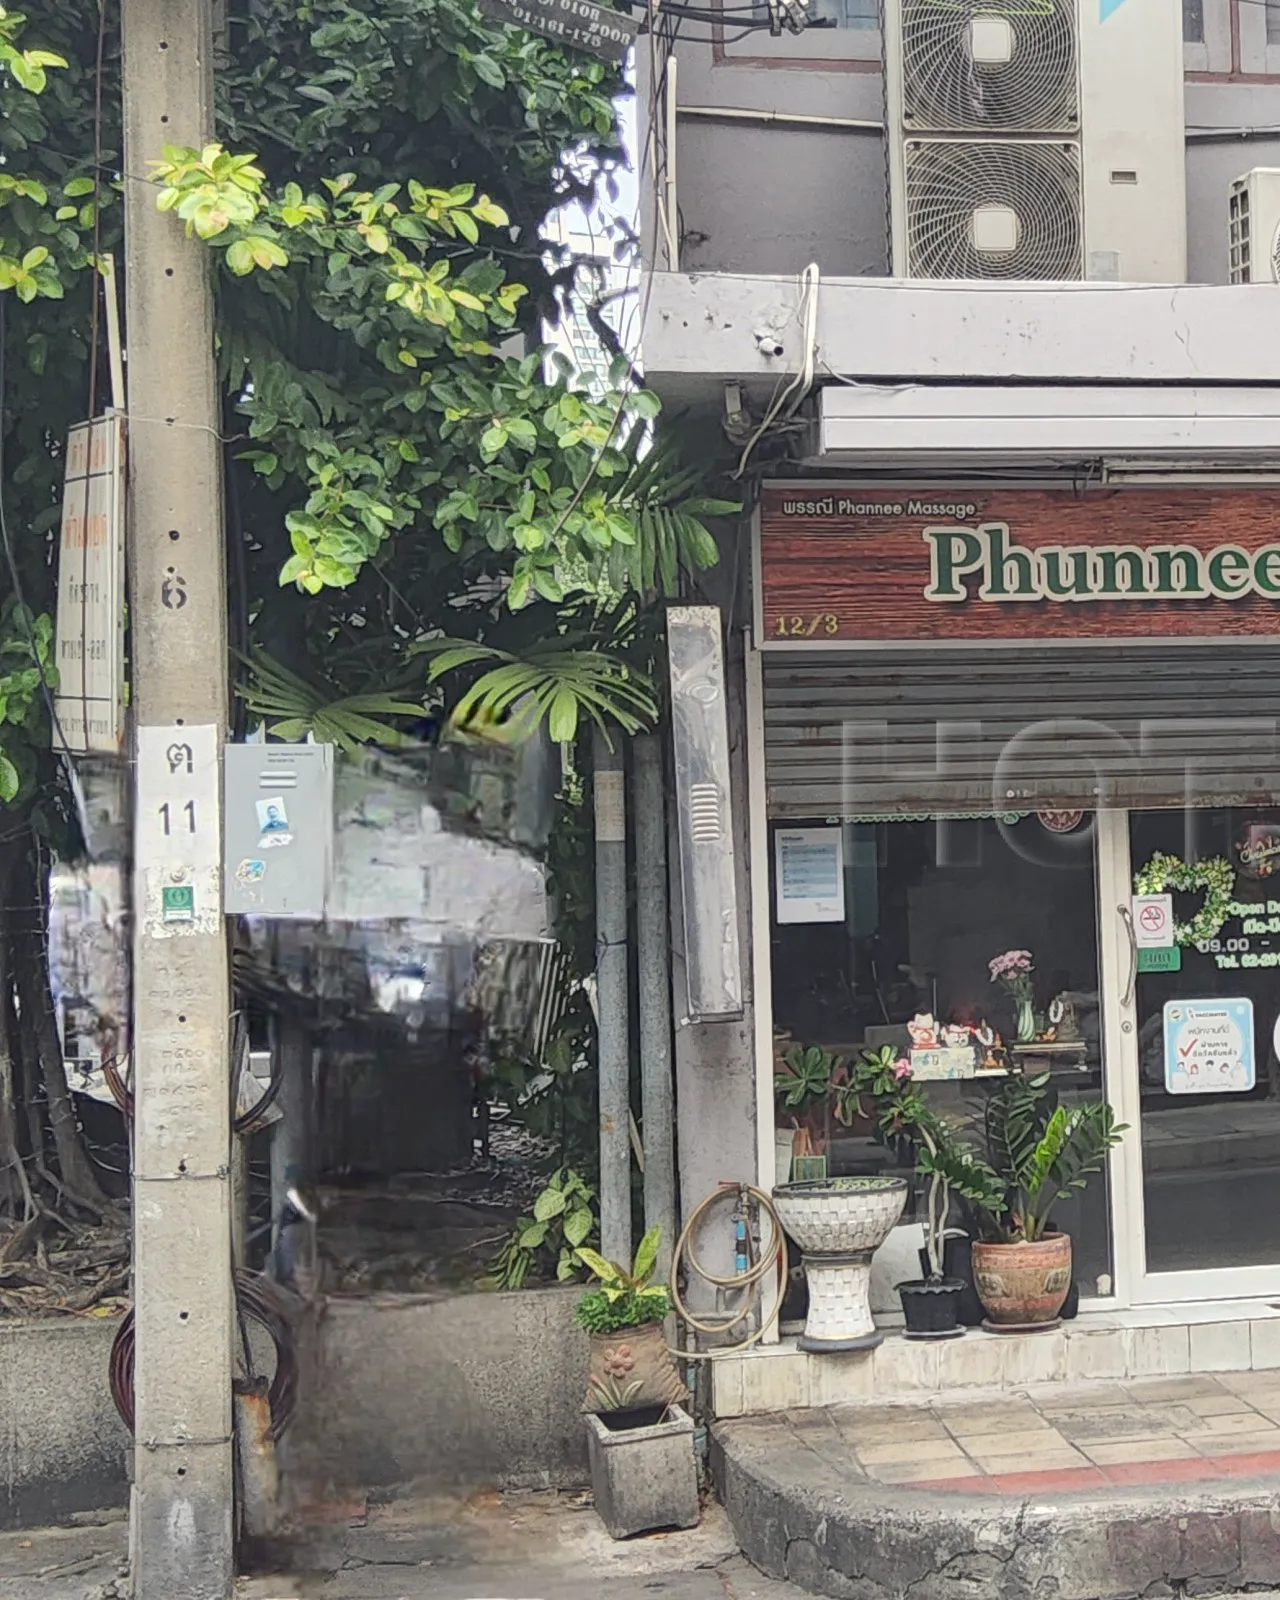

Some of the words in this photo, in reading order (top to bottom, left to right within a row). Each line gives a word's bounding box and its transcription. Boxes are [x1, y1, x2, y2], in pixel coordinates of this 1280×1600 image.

[783, 497, 833, 515] พรรณี
[838, 500, 903, 516] Phannee
[907, 501, 976, 519] Massage
[775, 615, 839, 638] 12/3
[1230, 901, 1265, 917] Open
[1198, 938, 1249, 953] 09.00
